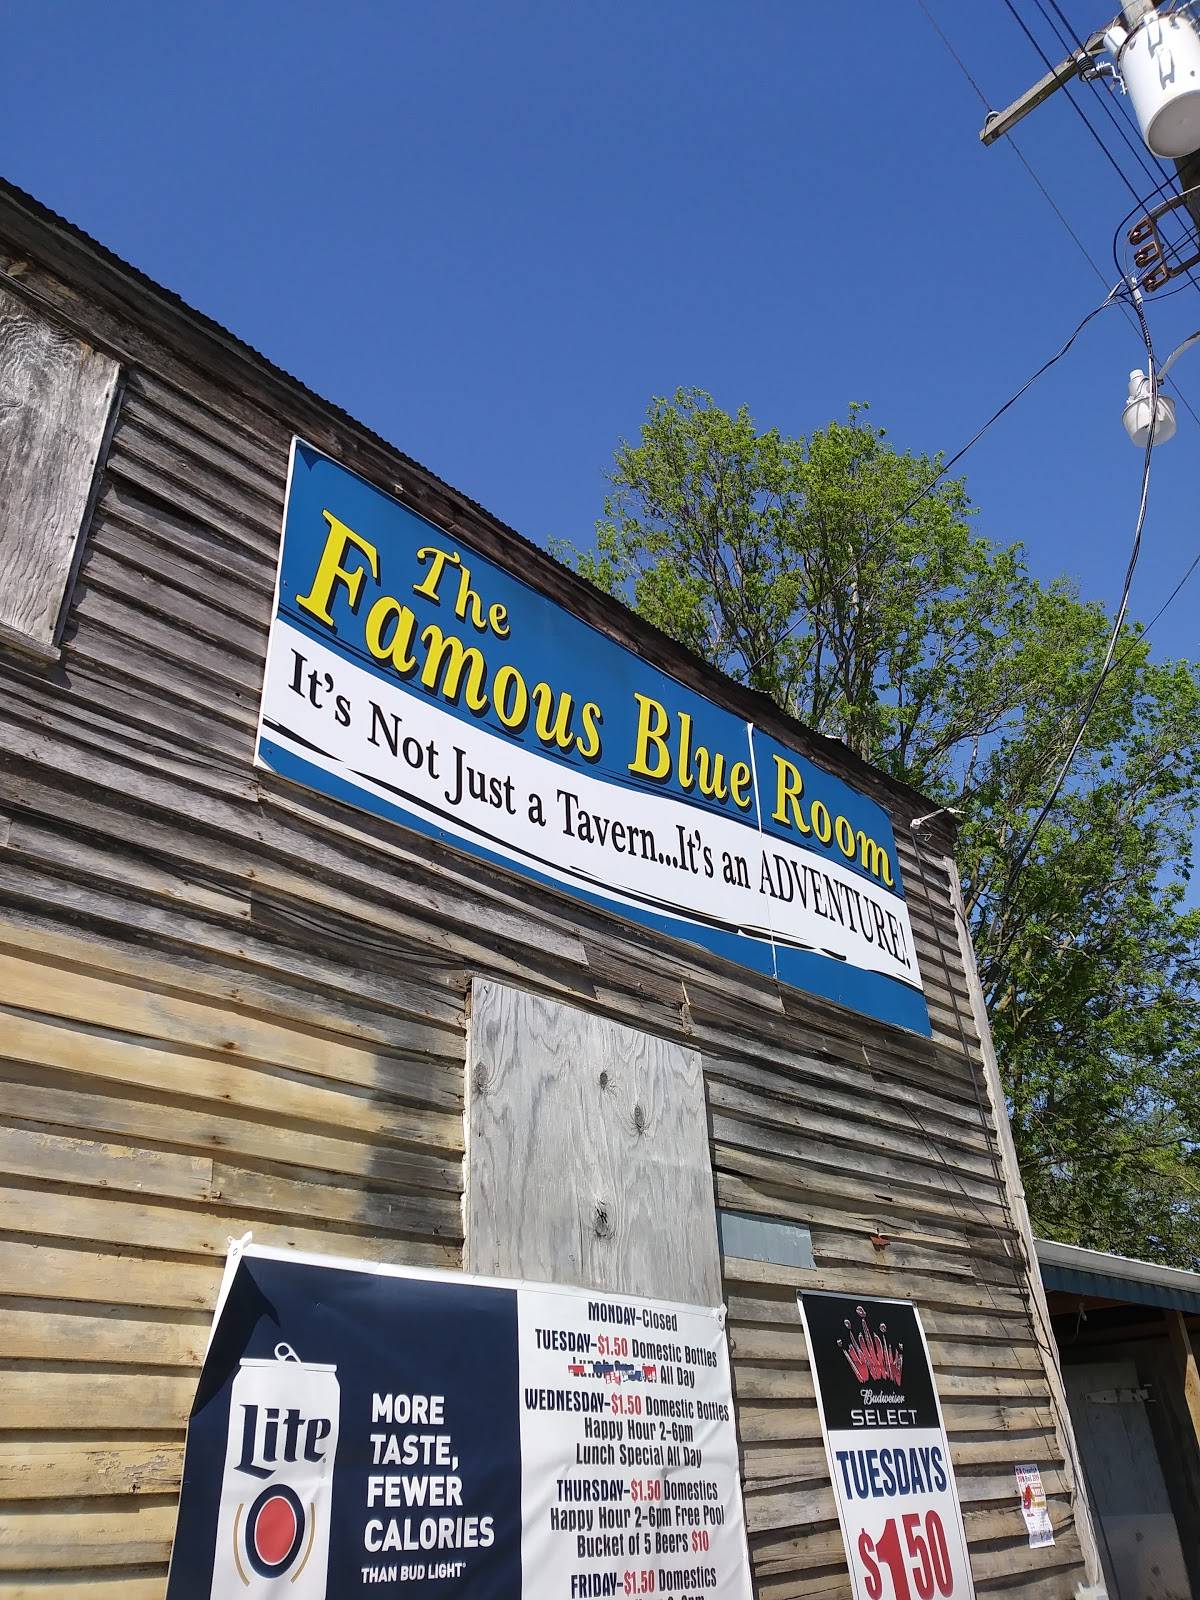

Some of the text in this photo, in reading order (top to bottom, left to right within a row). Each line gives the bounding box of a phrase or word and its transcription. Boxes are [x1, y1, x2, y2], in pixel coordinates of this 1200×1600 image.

[412, 546, 511, 638] The
[295, 508, 895, 888] Famous Blue Room
[288, 648, 351, 727] It's
[367, 700, 440, 779] Not
[444, 746, 516, 815] Just
[528, 793, 547, 827] a
[722, 851, 752, 890] an
[759, 850, 911, 970] ADVENTURE!
[632, 1338, 682, 1364] Domestic
[684, 1346, 717, 1368] Bottles
[660, 1365, 674, 1385] All
[677, 1366, 695, 1388] Day
[371, 1393, 445, 1425] MORE
[645, 1395, 694, 1419] Domestic
[697, 1400, 730, 1422] Bottles
[860, 1389, 905, 1405] Budweiser
[584, 1417, 694, 1443] Happy Hour 2-6pm
[851, 1409, 918, 1426] SELECT
[233, 1404, 332, 1480] Lite
[370, 1434, 459, 1472] TASTE,
[576, 1443, 702, 1468] Lunch Special All Day
[836, 1446, 947, 1500] TUESDAYS
[367, 1475, 464, 1508] FEWER
[664, 1479, 718, 1500] Domestics
[550, 1504, 725, 1532] Happy Hour 2-6pm Free Pool
[364, 1517, 495, 1553] CALORIES
[577, 1529, 709, 1558] Bucket of 5 Beers $10
[361, 1567, 397, 1584] THAN
[400, 1564, 425, 1582] BUD
[658, 1566, 717, 1592] Domestics
